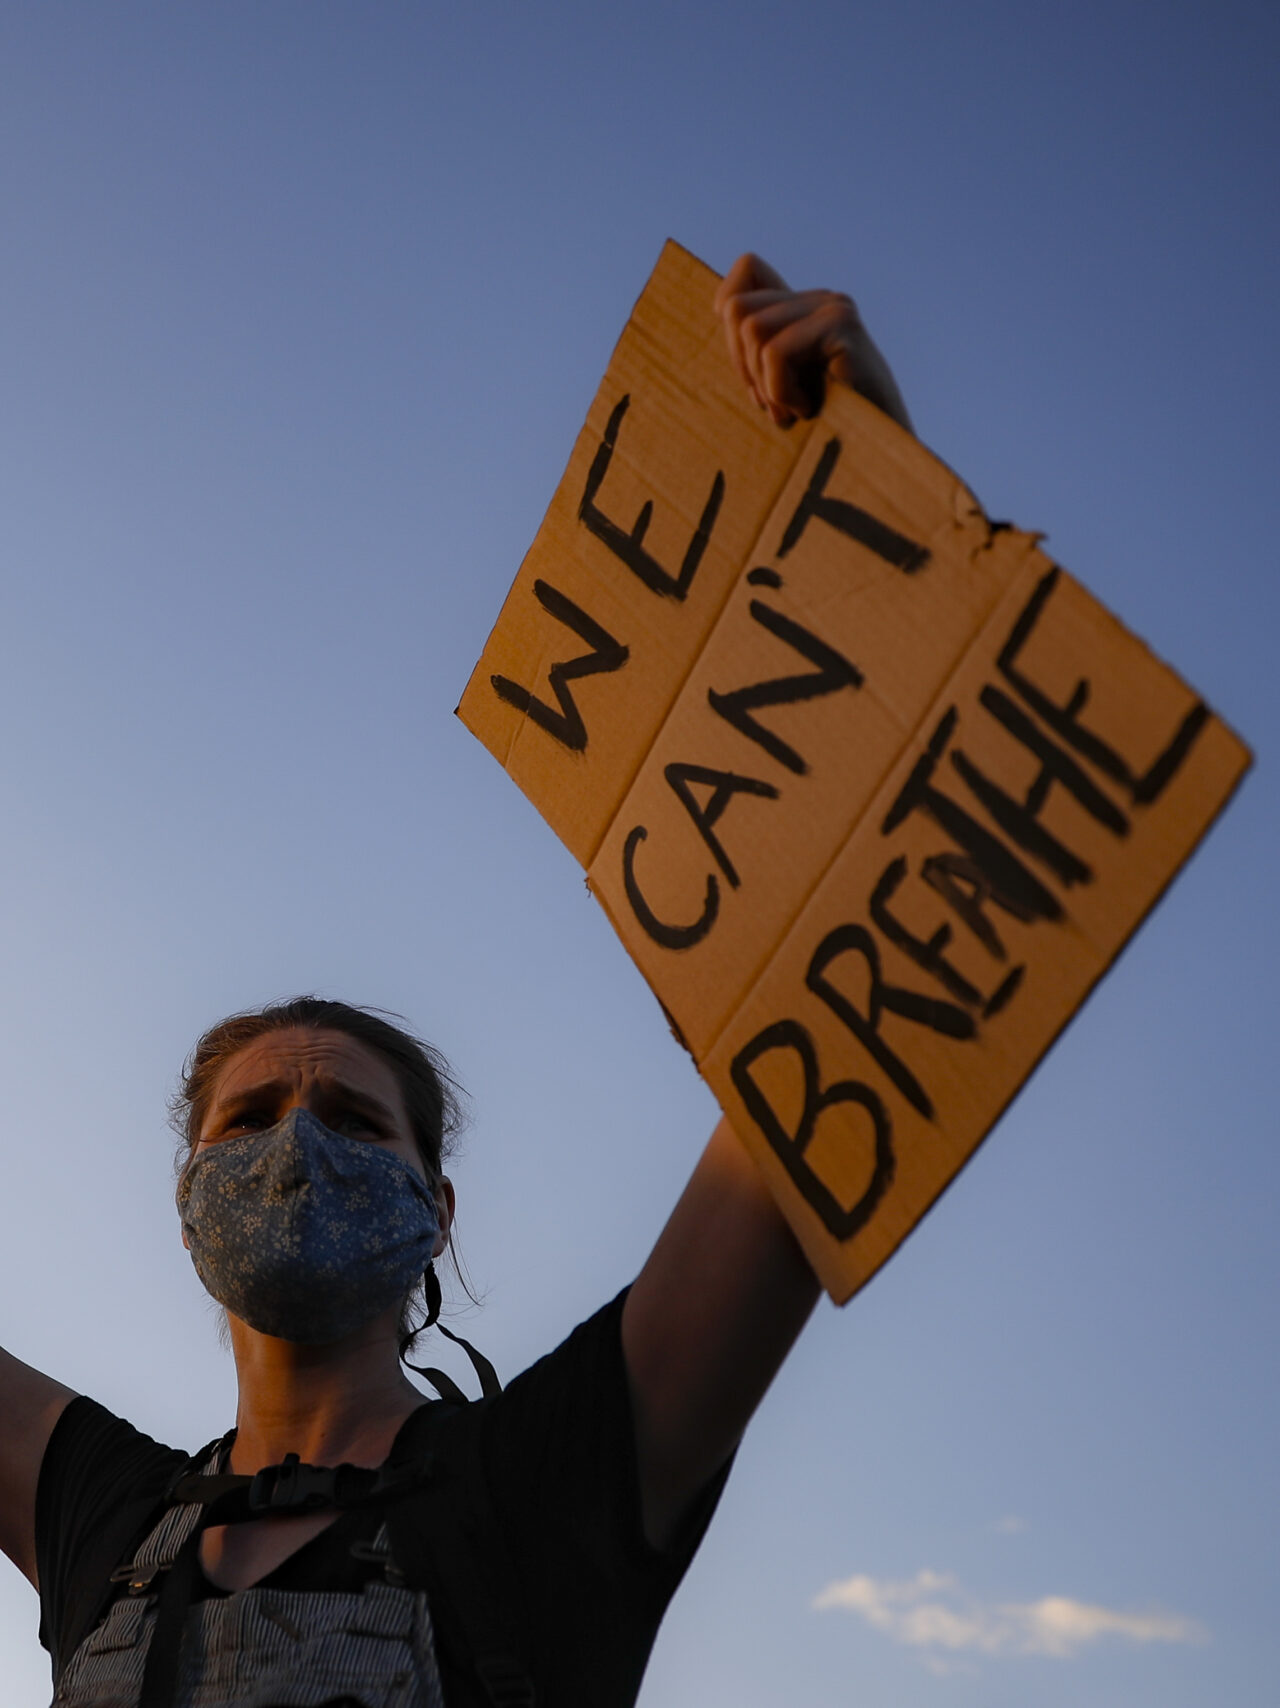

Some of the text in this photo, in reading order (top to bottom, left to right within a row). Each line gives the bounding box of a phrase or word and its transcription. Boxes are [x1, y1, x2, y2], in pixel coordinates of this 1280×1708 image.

[491, 394, 725, 752] WE
[622, 437, 931, 950] CAN'T
[730, 568, 1211, 1240] BREATHE
